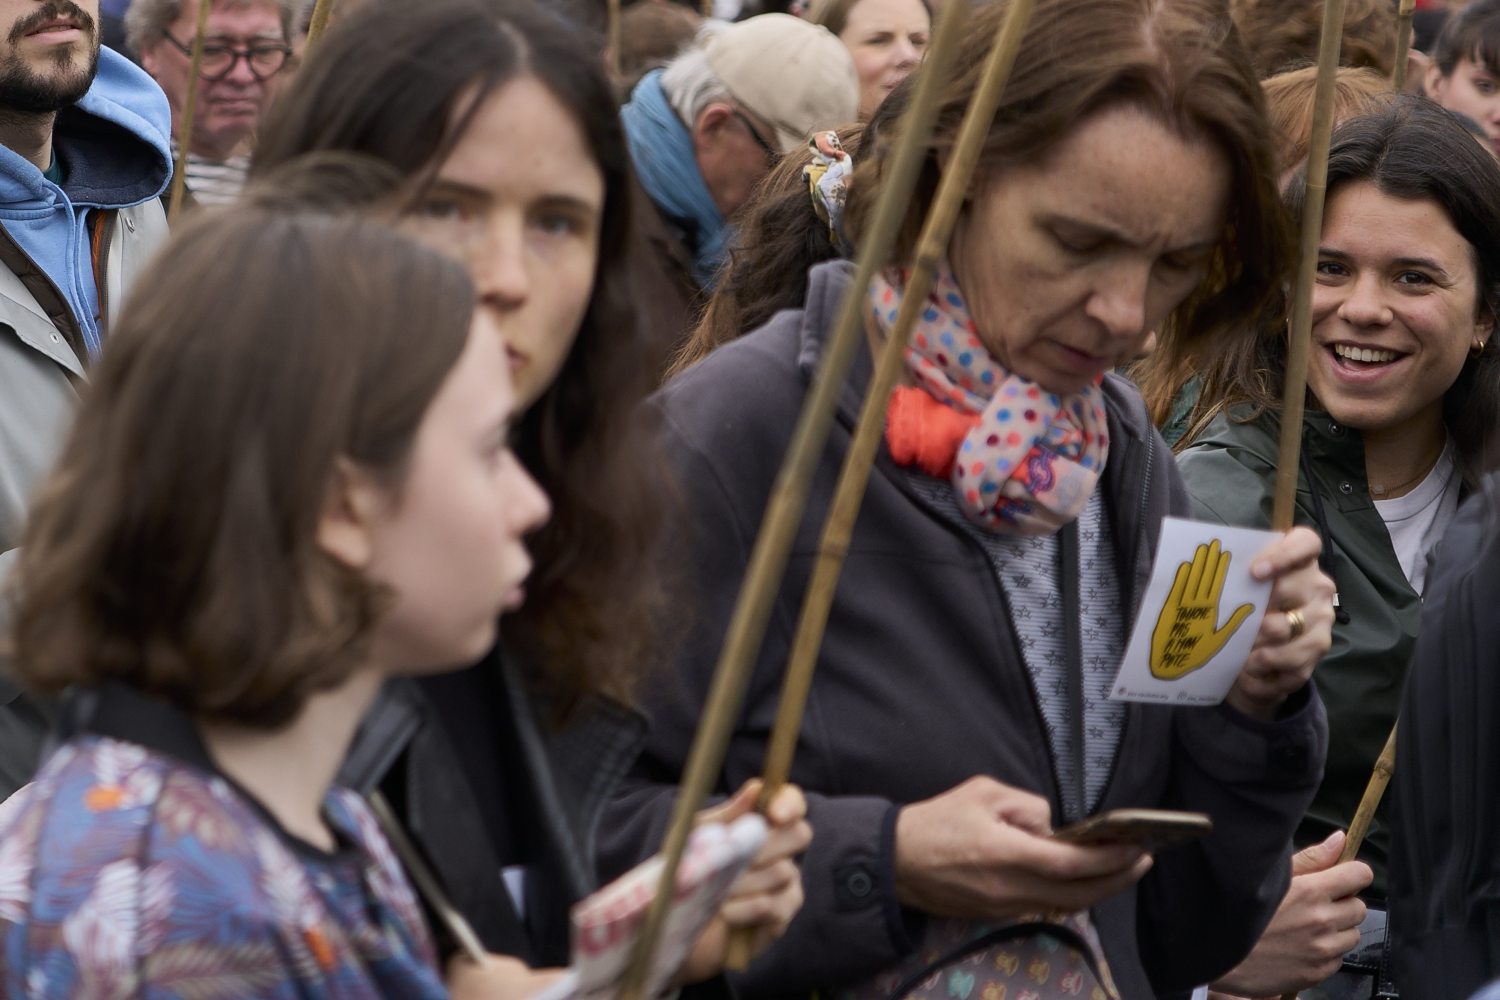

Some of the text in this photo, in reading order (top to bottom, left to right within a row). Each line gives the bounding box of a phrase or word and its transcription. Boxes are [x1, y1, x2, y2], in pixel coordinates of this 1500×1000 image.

[1176, 606, 1214, 621] TOUCHE
[1169, 622, 1191, 638] PAS
[1164, 634, 1203, 653] A MON
[1159, 652, 1191, 668] POTE
